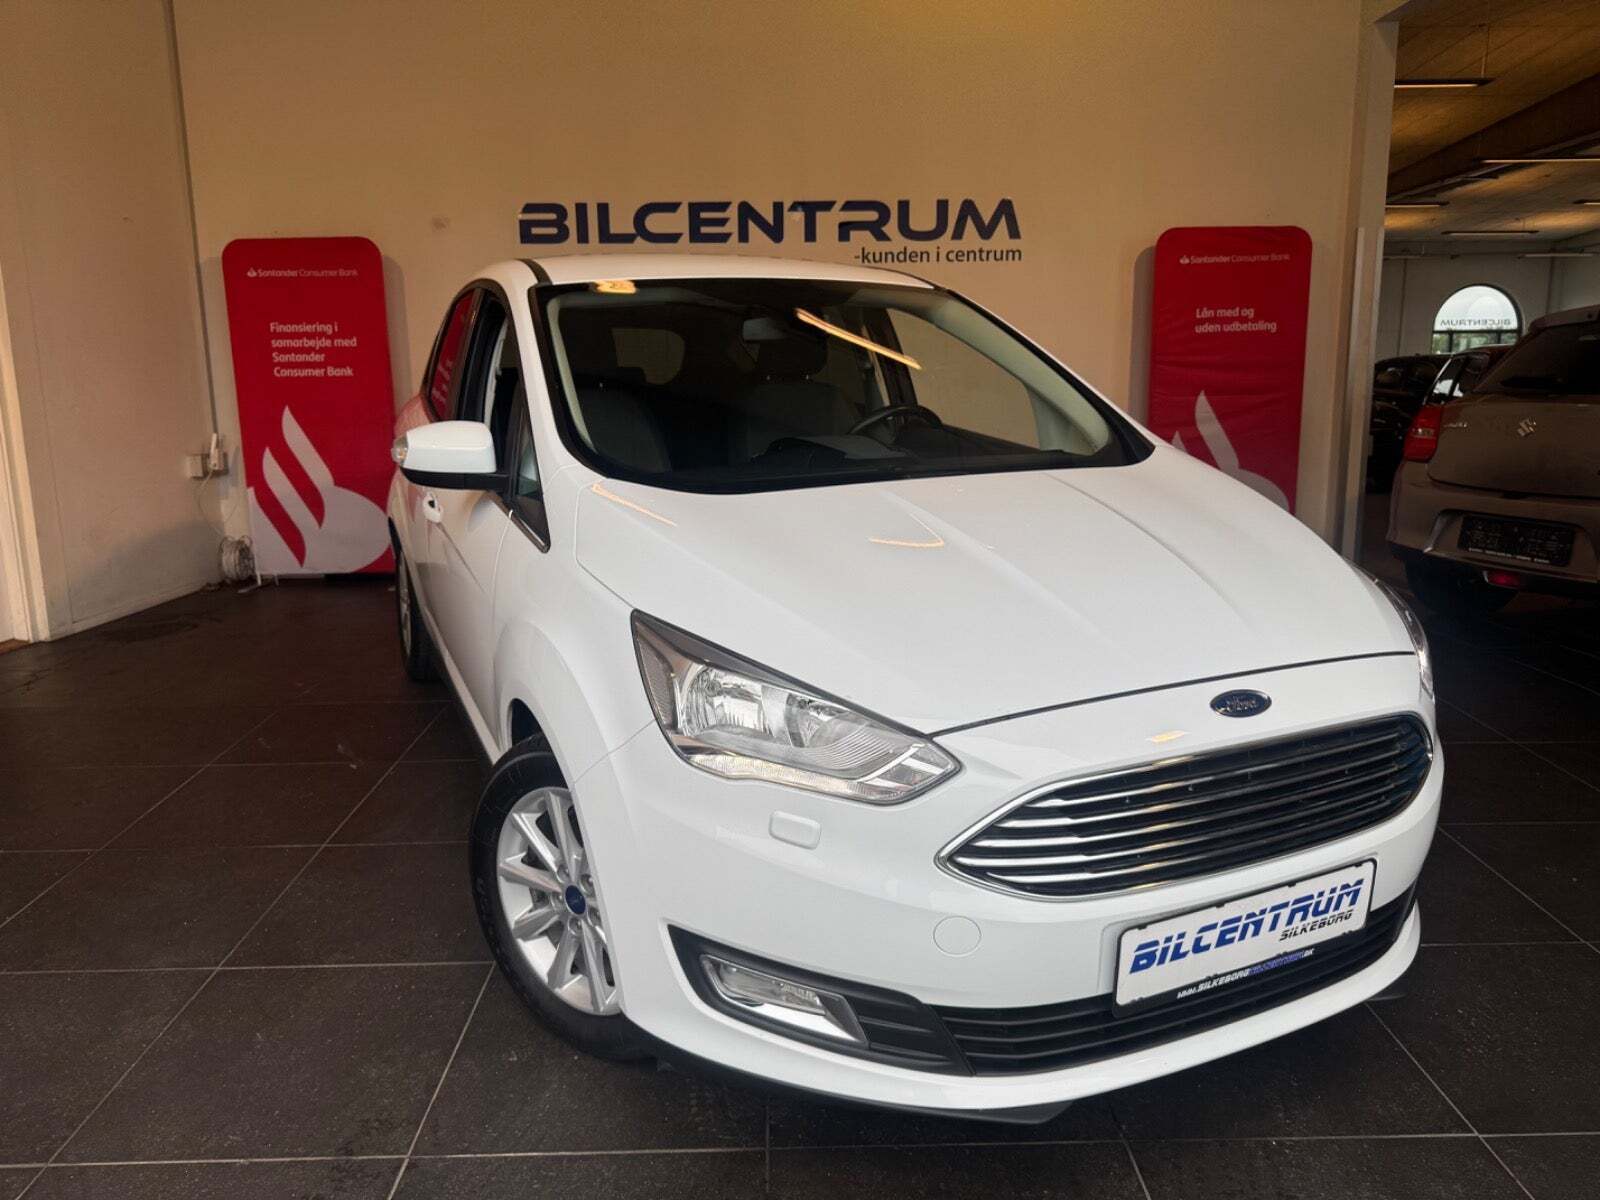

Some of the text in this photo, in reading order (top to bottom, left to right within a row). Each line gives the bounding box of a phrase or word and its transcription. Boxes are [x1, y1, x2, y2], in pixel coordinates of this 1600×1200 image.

[519, 198, 1022, 245] BILCENTRUM
[854, 246, 1022, 264] -kunden i centrum
[1190, 253, 1290, 264] Santander Consumer Bank
[257, 268, 358, 277] Santander Consumer Bank
[1196, 306, 1254, 318] Lån med og
[270, 321, 333, 335] Finansiering
[1195, 320, 1277, 333] uden udbetaling
[271, 337, 357, 350] samarbejde med
[272, 352, 325, 362] Santander
[274, 366, 353, 377] Consumer Bank
[1129, 878, 1365, 974] BILCENTRUM
[1279, 909, 1354, 942] SILKEBORG
